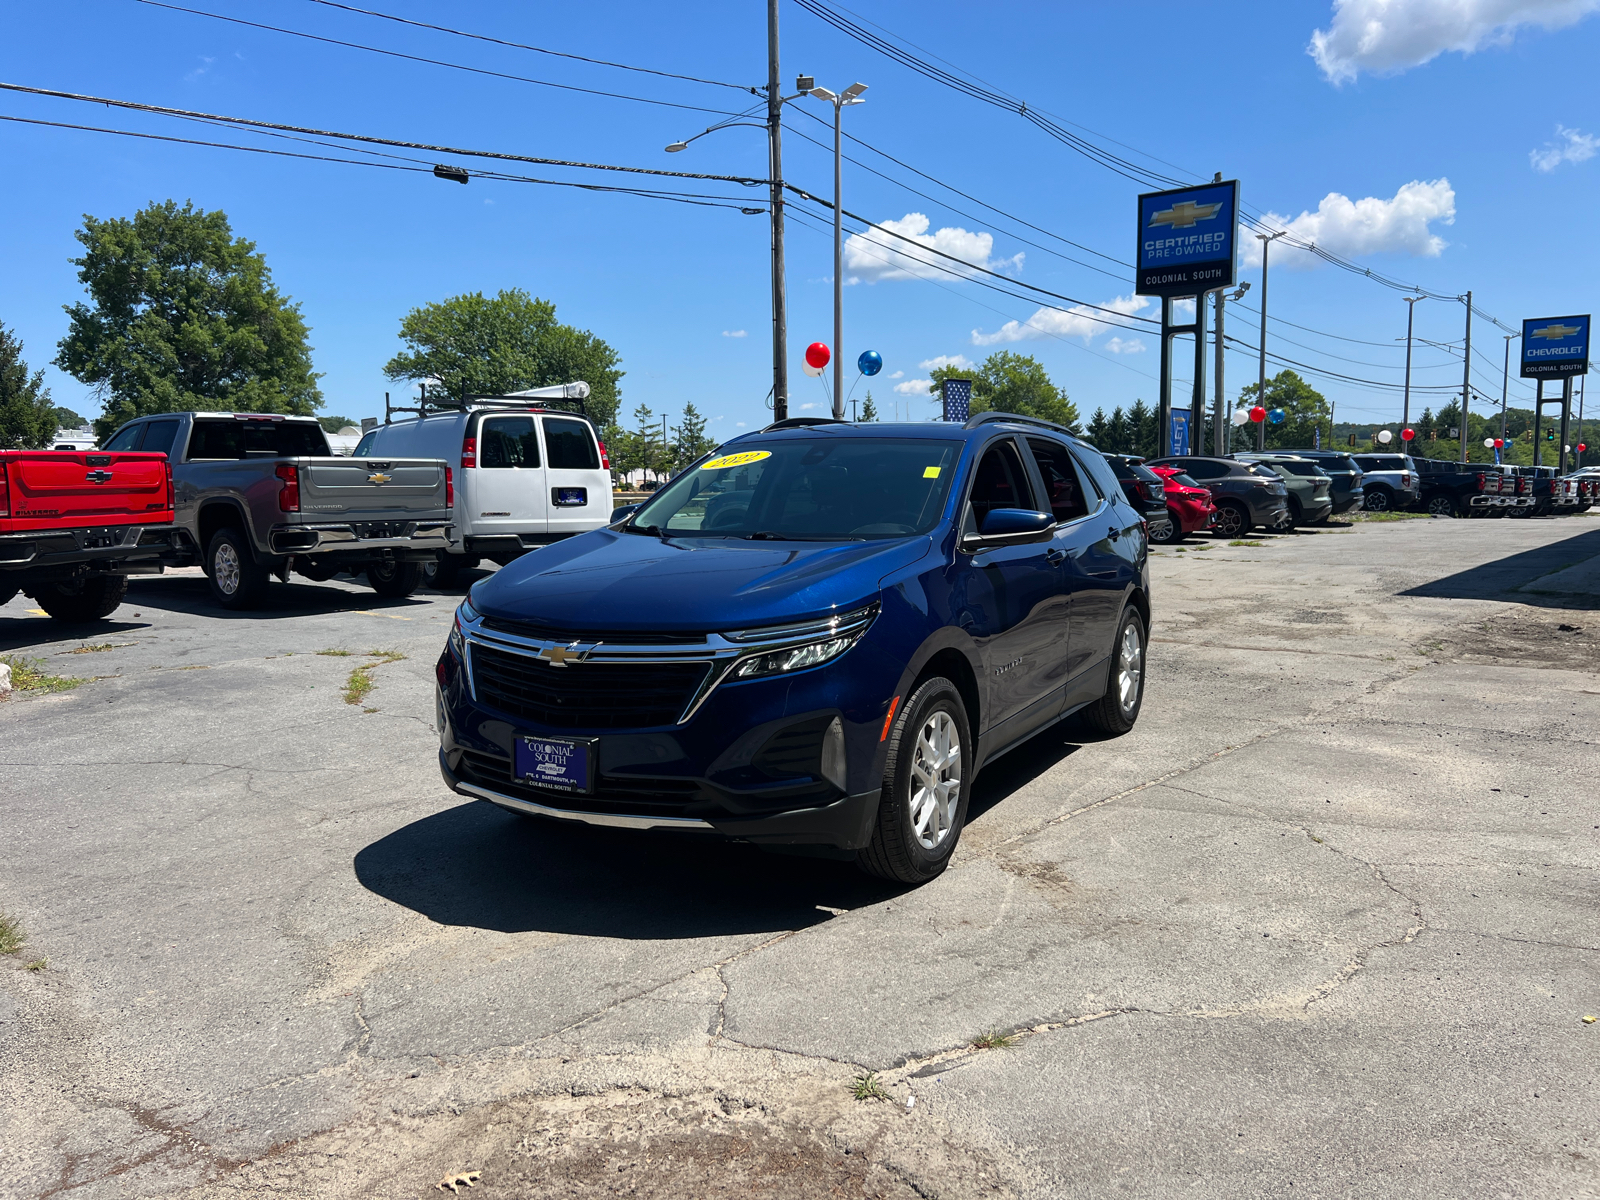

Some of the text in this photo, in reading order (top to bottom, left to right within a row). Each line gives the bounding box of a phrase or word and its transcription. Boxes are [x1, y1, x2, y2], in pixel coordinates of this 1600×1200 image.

[1144, 231, 1226, 251] CERTIFIED
[1148, 242, 1221, 259] PRE-OWNED
[1145, 269, 1222, 285] COLONIAL SOUTH
[1527, 345, 1583, 357] CHEVROLET
[1525, 363, 1582, 373] COLONIAL SOUTH
[709, 452, 761, 468] 2022
[528, 743, 573, 756] COLONIAL
[535, 752, 566, 764] SOUTH
[554, 784, 572, 792] SOUTH
